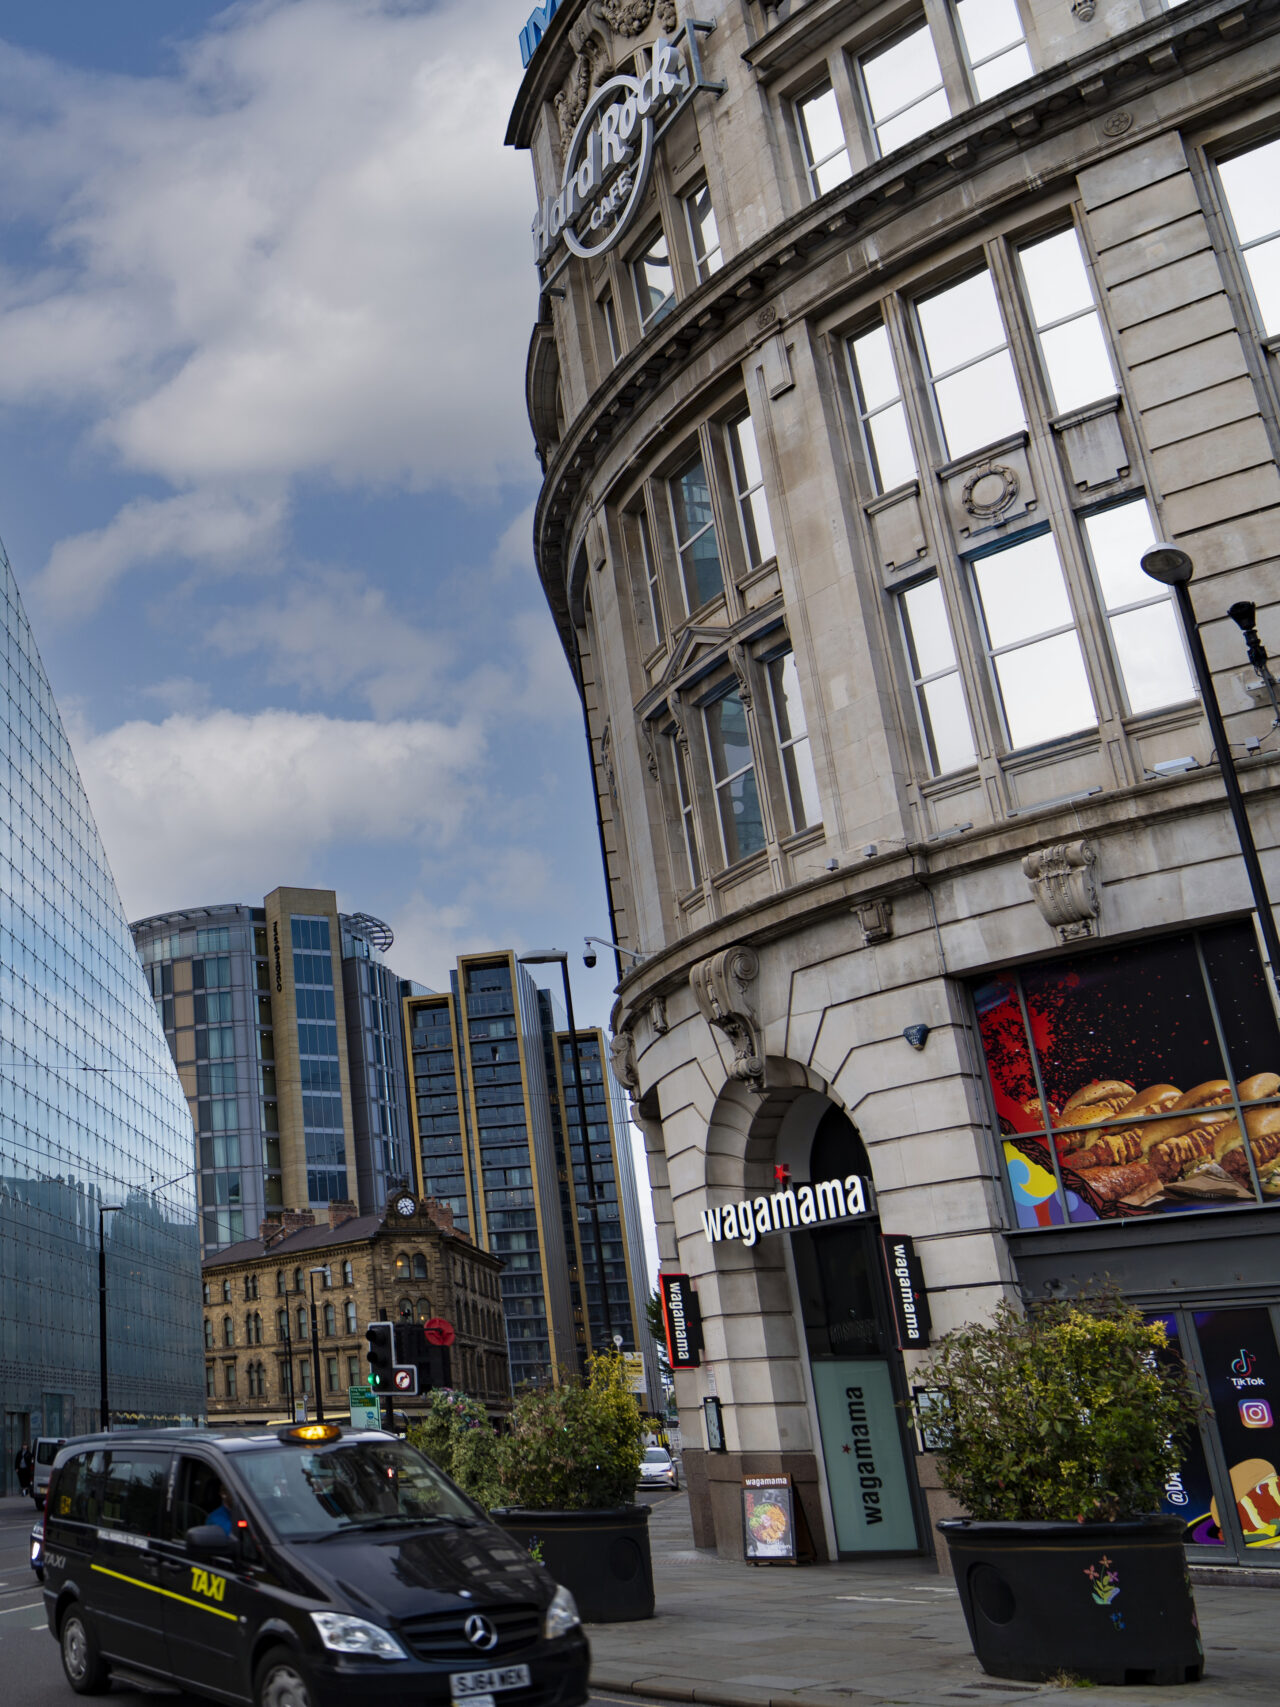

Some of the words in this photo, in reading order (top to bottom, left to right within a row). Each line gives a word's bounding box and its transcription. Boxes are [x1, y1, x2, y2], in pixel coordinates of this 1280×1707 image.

[533, 131, 602, 265] Hard
[598, 37, 690, 172] Rock
[700, 1175, 866, 1247] wagamama
[669, 1282, 690, 1361] wagamama
[893, 1244, 921, 1340] wagamama
[1231, 1377, 1265, 1386] TikTok
[745, 1477, 788, 1488] wagamama
[846, 1386, 883, 1525] wagamama
[44, 1551, 66, 1569] TAXI
[191, 1566, 227, 1602] TAXI
